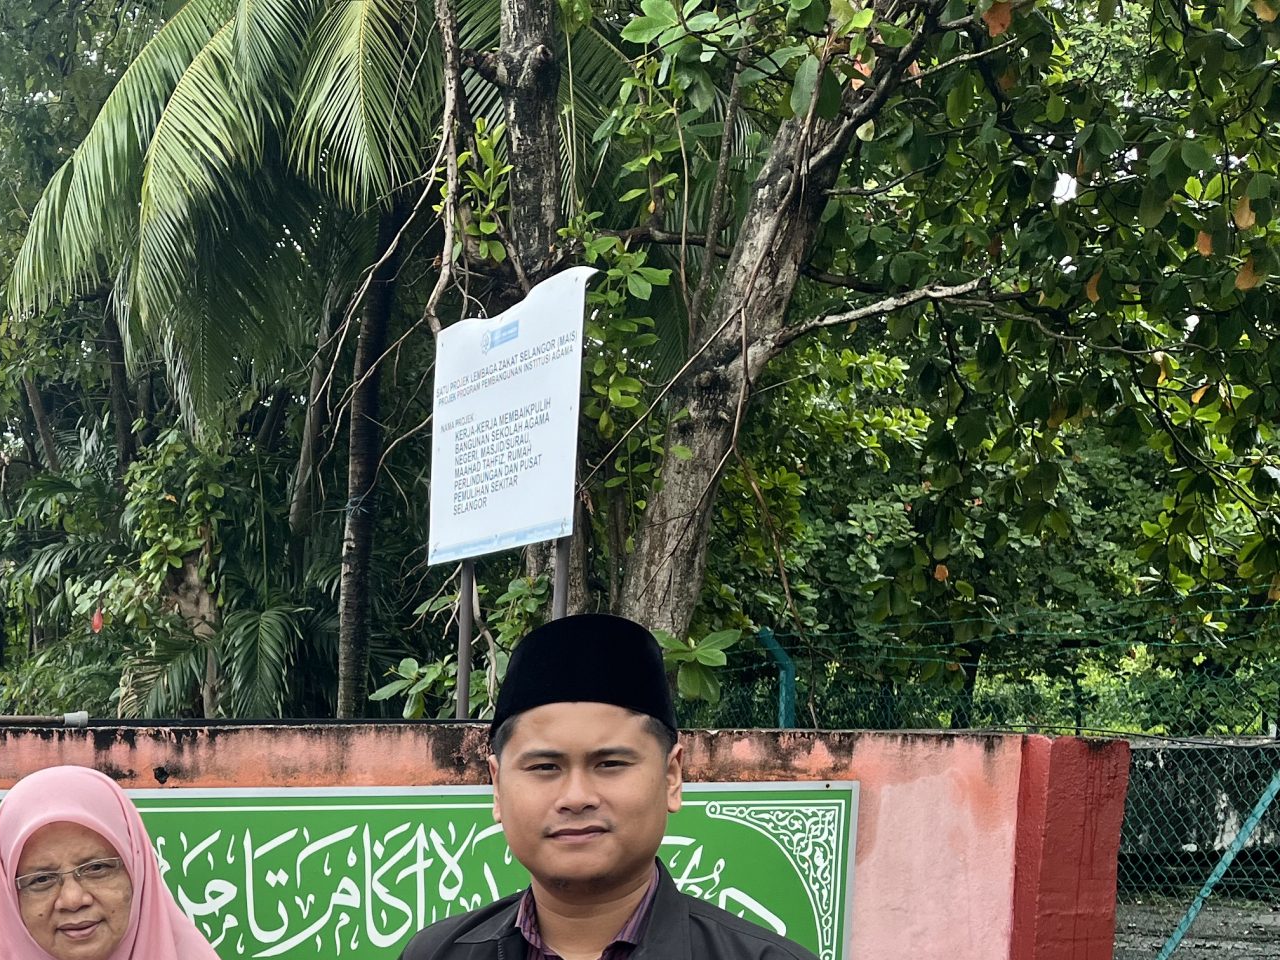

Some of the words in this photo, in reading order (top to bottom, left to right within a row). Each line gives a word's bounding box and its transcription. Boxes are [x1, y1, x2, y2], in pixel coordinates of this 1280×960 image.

[436, 385, 450, 398] SATU
[450, 376, 470, 394] PROJEK
[470, 364, 498, 382] LEMBAGA
[498, 354, 518, 371] ZAKAT
[520, 338, 556, 362] SELANGOR
[438, 391, 456, 406] PROJEK
[457, 383, 481, 400] PROGRAM
[482, 364, 522, 390] PEMBANGUNAN
[524, 354, 550, 373] INSTITUSI
[551, 346, 574, 361] AGAMA
[440, 422, 454, 432] NAMA
[455, 418, 498, 442] KERJA-KERJA
[498, 398, 551, 424] MEMBAIKPULIH
[455, 434, 490, 454] BANGUNAN
[492, 422, 522, 442] SEKOLAH
[524, 412, 550, 428] AGAMA
[454, 462, 481, 478] MAAHAD
[507, 445, 532, 462] RUMAH
[454, 470, 503, 490] PERLINDUNGAN
[504, 462, 518, 475] DAN
[520, 454, 542, 471] PUSAT
[453, 496, 488, 516] SELANGOR
[454, 484, 490, 503] PEMULIHAN
[490, 475, 518, 493] SEKITAR
